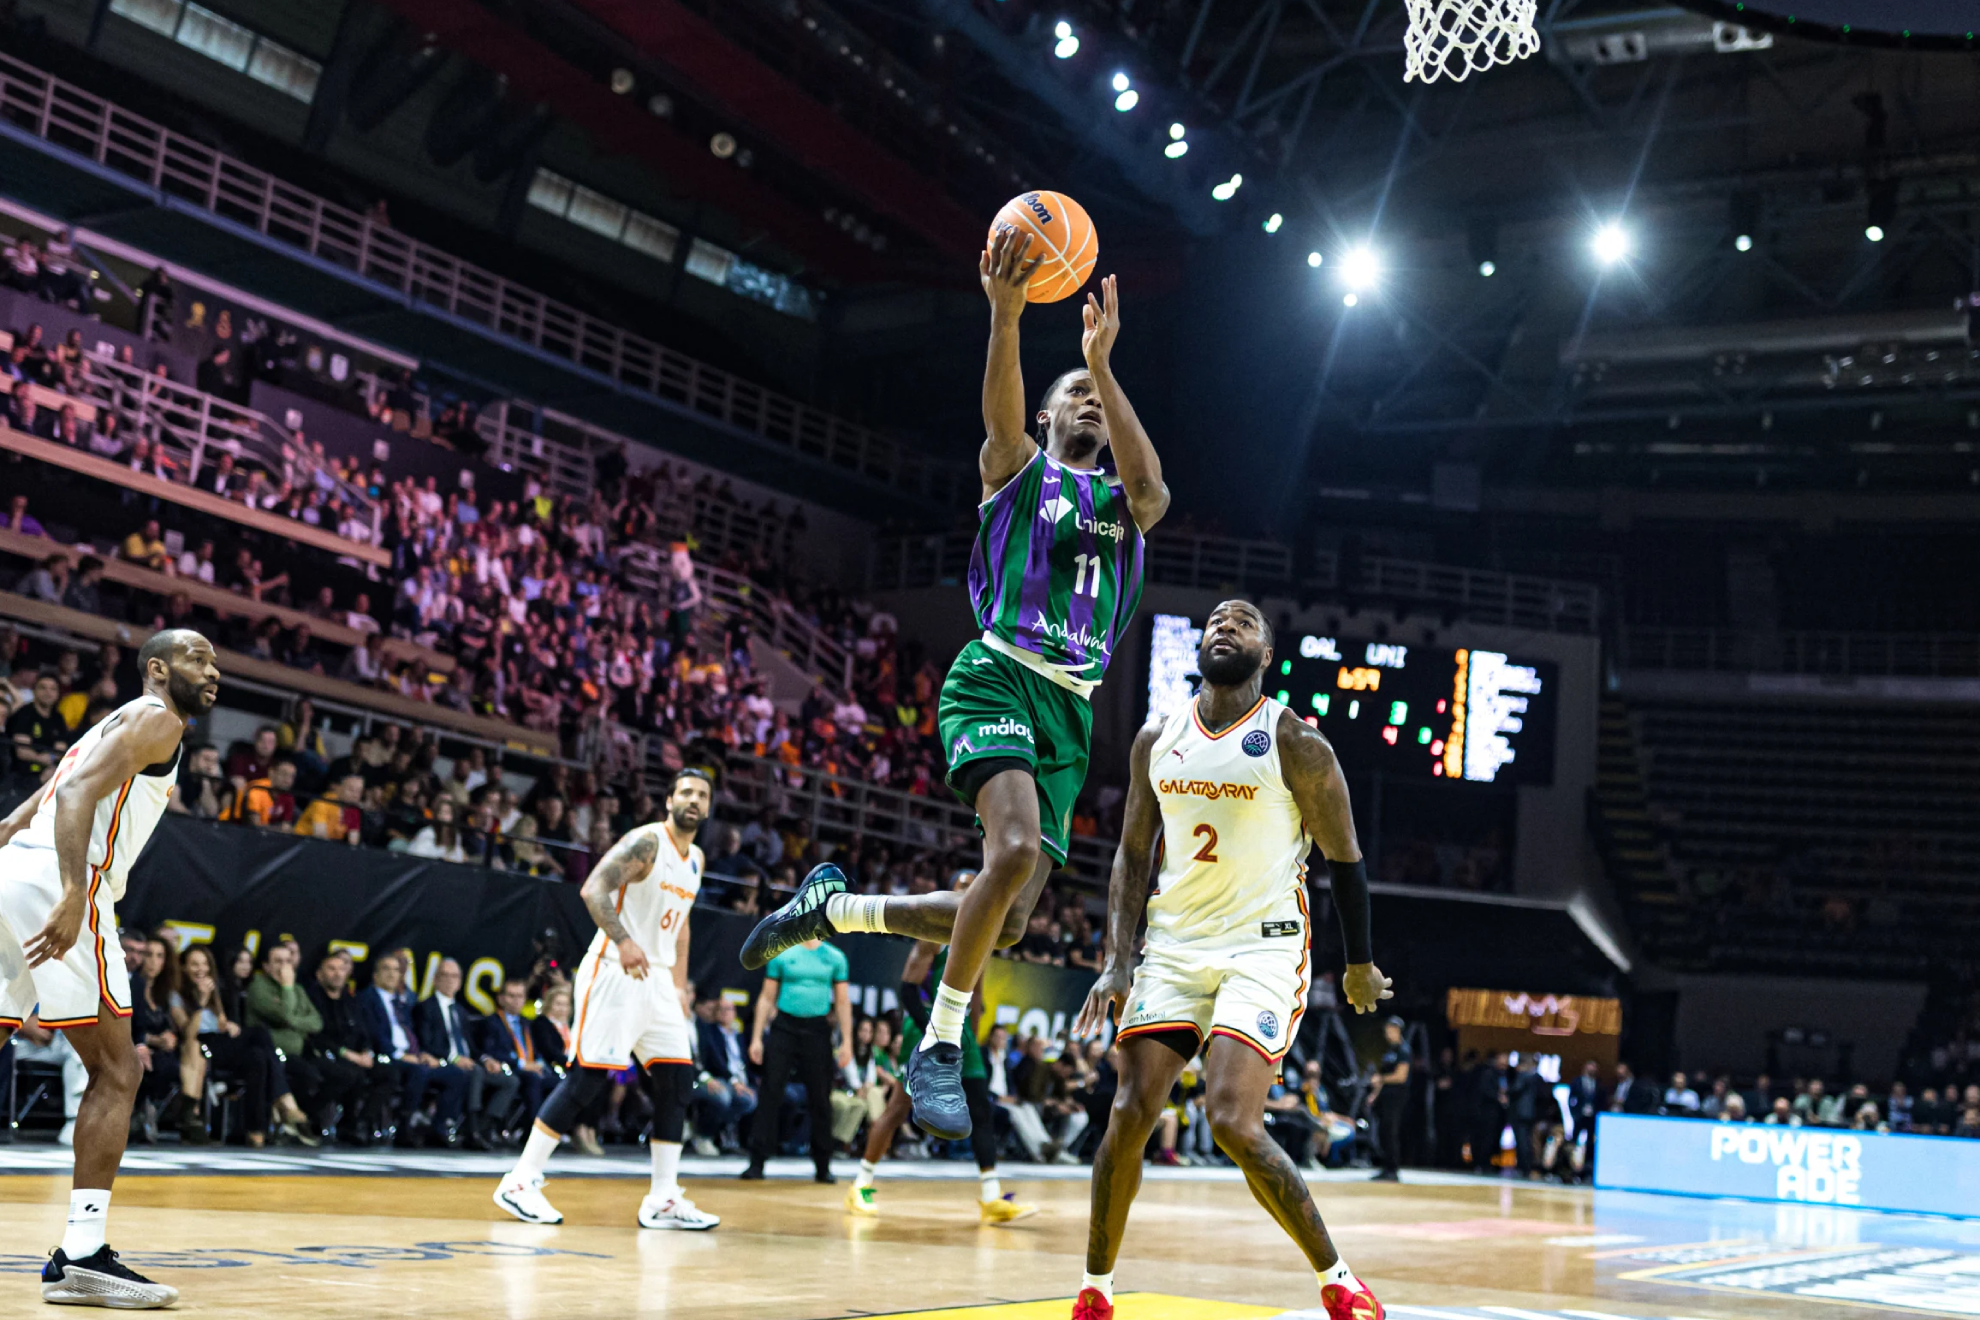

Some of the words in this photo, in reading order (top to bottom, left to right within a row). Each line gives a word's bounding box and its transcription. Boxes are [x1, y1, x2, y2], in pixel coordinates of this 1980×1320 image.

[1074, 553, 1101, 599] 11
[1159, 779, 1260, 800] GALATASARAY
[1192, 823, 1219, 863] 2
[660, 908, 681, 935] 61
[1711, 1126, 1862, 1171] POWER
[1777, 1164, 1862, 1204] ADE
